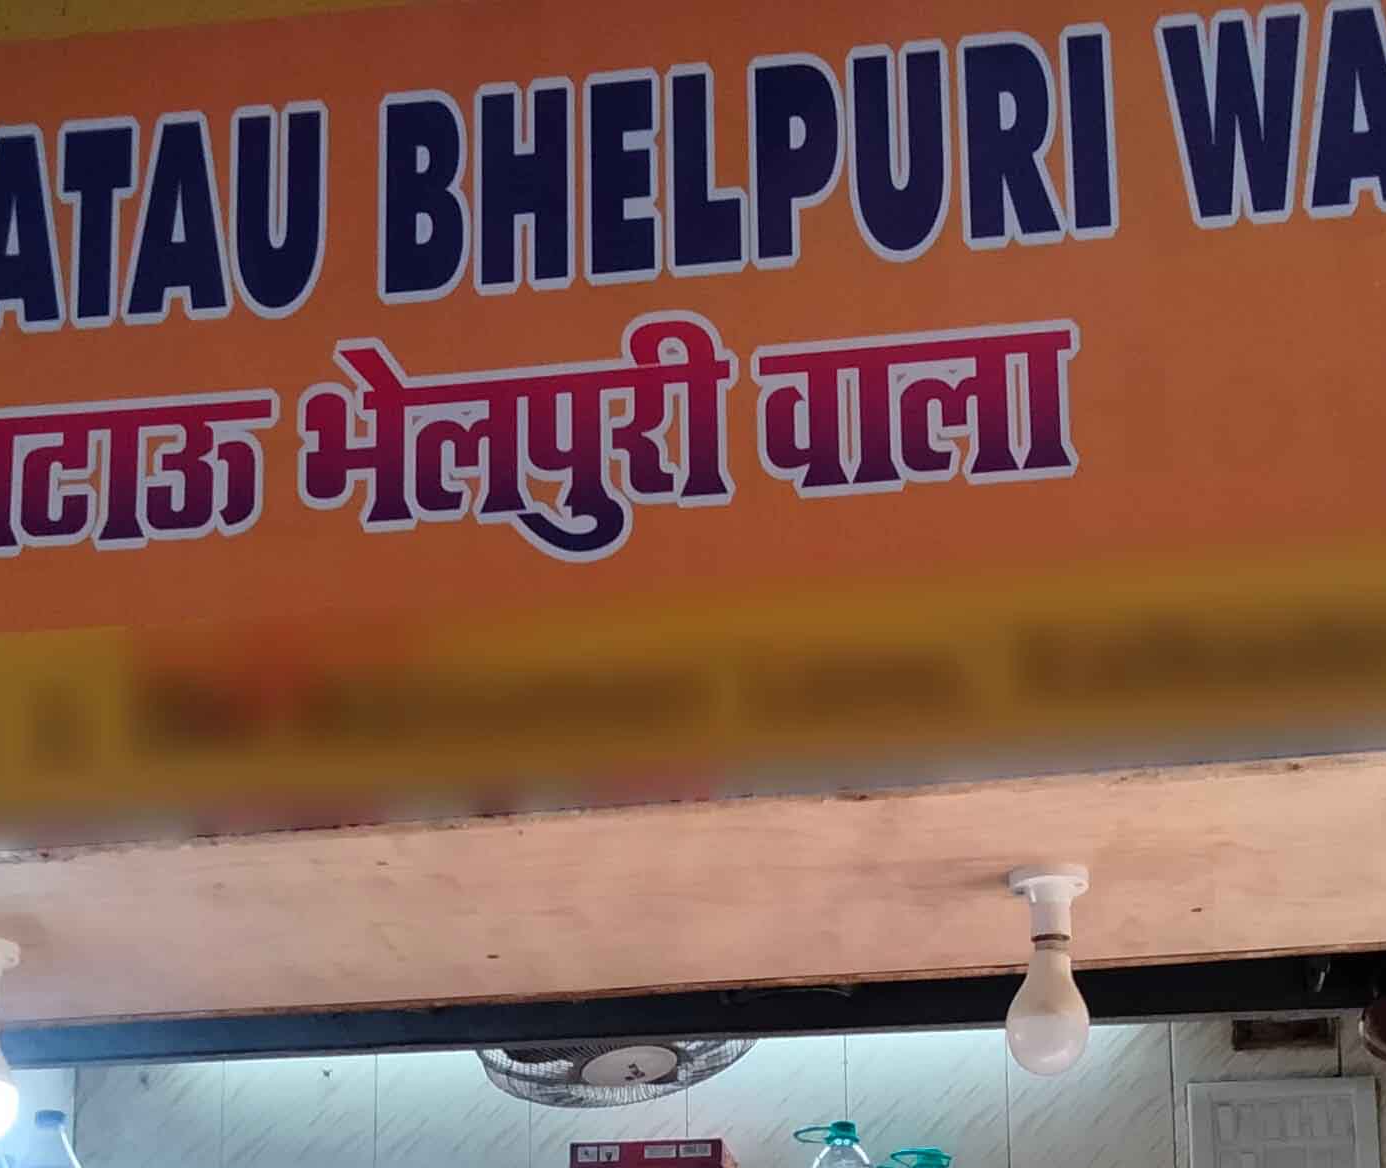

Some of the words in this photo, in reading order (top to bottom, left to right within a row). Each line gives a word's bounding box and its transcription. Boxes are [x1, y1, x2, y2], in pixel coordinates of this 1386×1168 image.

[378, 23, 1118, 303] BHELPURI
[298, 310, 735, 562] भेलपुरी
[754, 318, 1079, 497] वाला
